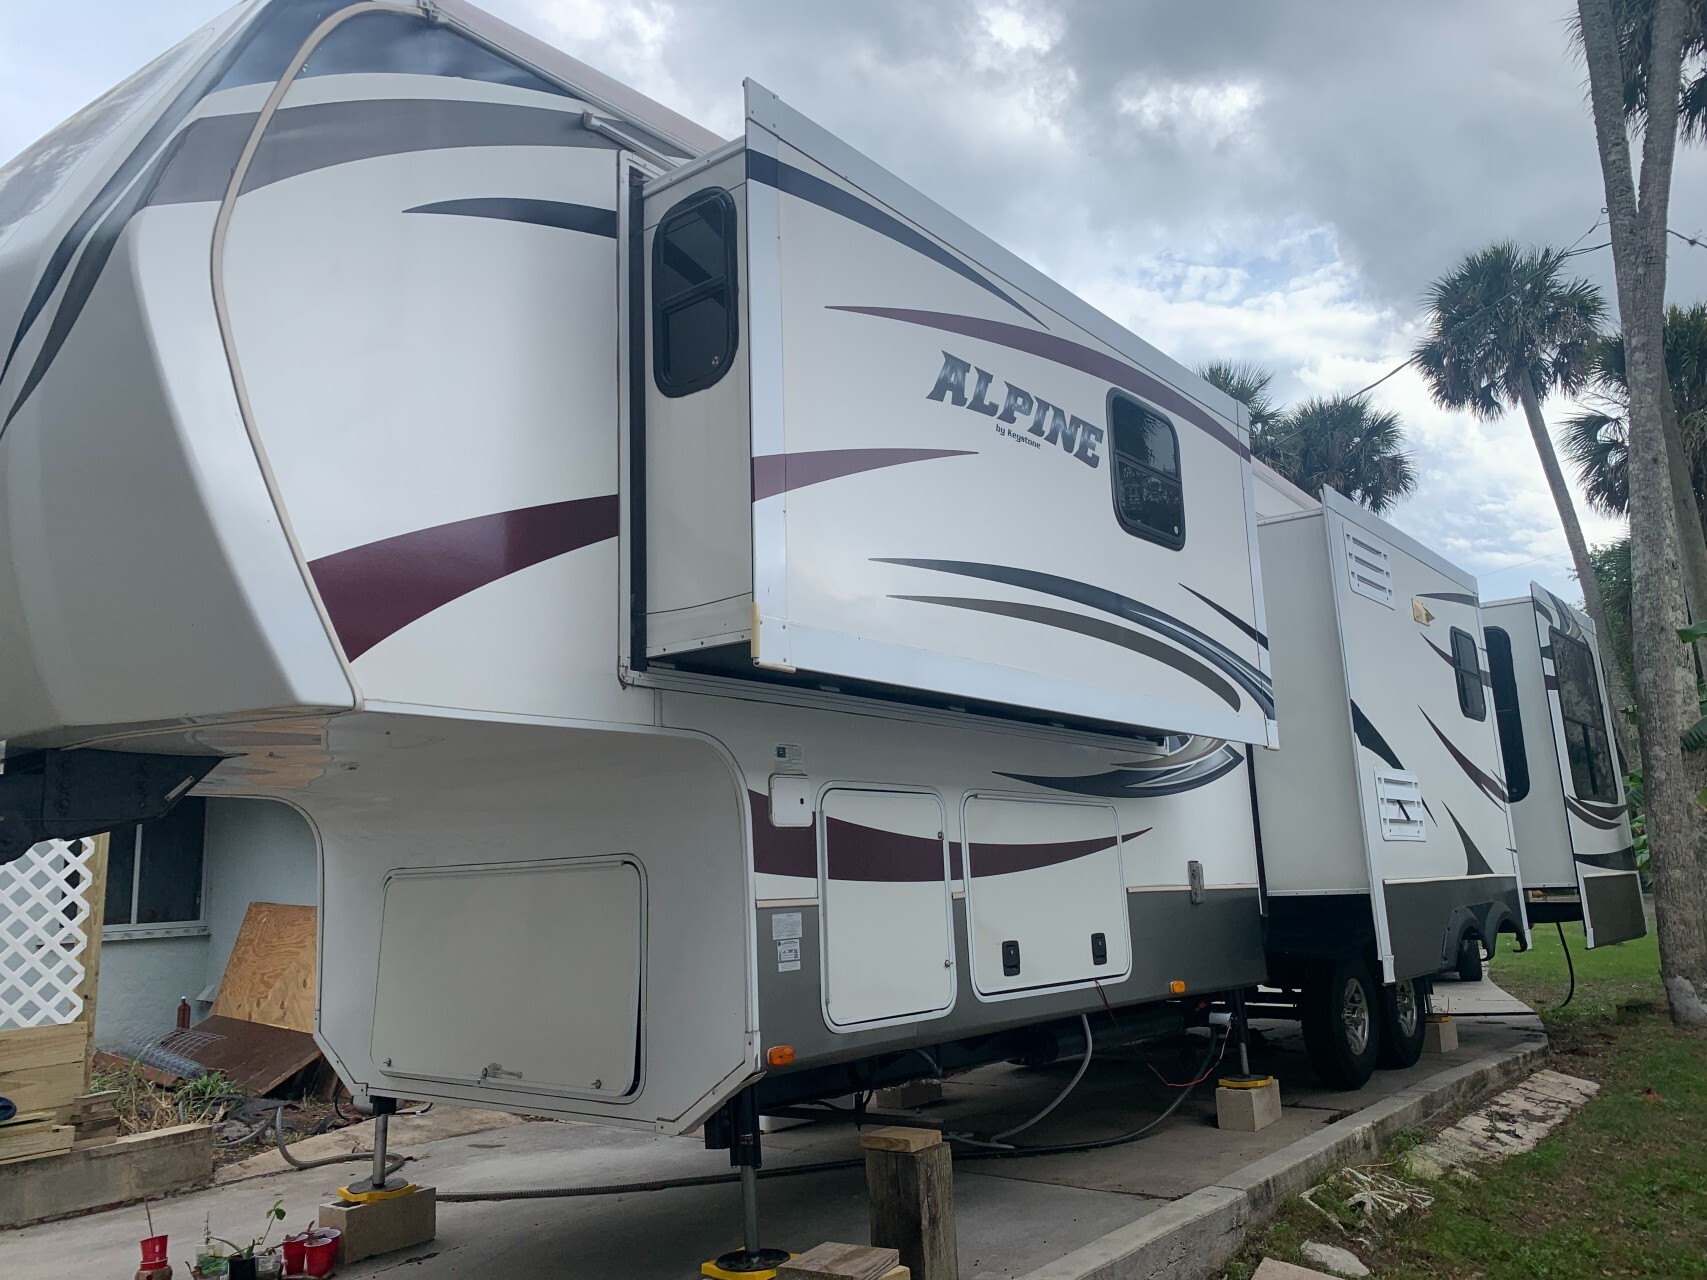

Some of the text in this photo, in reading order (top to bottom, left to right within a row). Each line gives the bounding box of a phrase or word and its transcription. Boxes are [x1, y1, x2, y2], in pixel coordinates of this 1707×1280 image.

[926, 350, 1104, 468] ALPINE
[995, 423, 1041, 449] by Keystone
